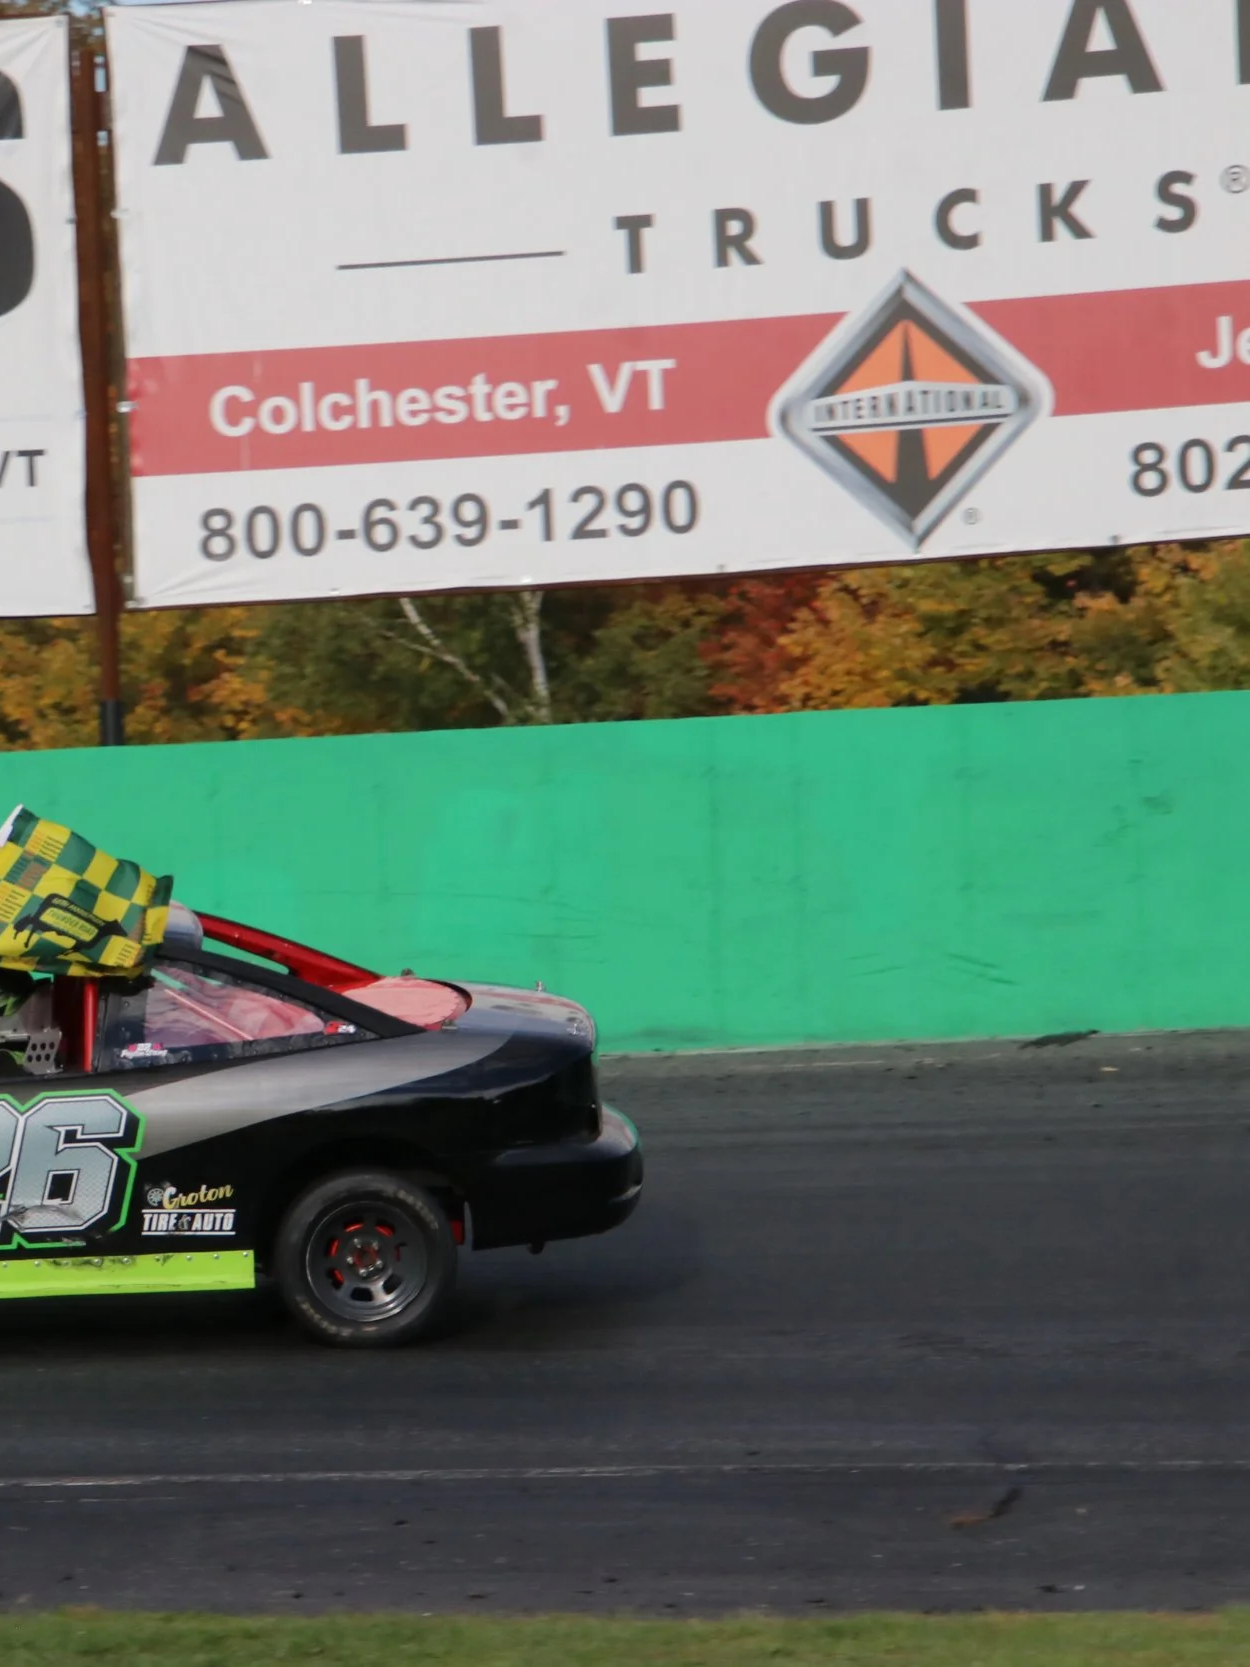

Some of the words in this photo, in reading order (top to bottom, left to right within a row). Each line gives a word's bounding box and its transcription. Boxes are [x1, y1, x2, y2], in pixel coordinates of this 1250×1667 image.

[152, 0, 1250, 166] ALLEGIA
[209, 374, 571, 437] Colchester,
[587, 359, 677, 413] VT
[814, 388, 1006, 423] INTERNATIONAL
[1129, 434, 1250, 497] 802
[198, 480, 700, 562] 800-639-1290
[142, 1213, 178, 1231] TIRE
[178, 1214, 191, 1231] &
[191, 1213, 235, 1231] AUTO
[162, 1184, 235, 1210] Groton
